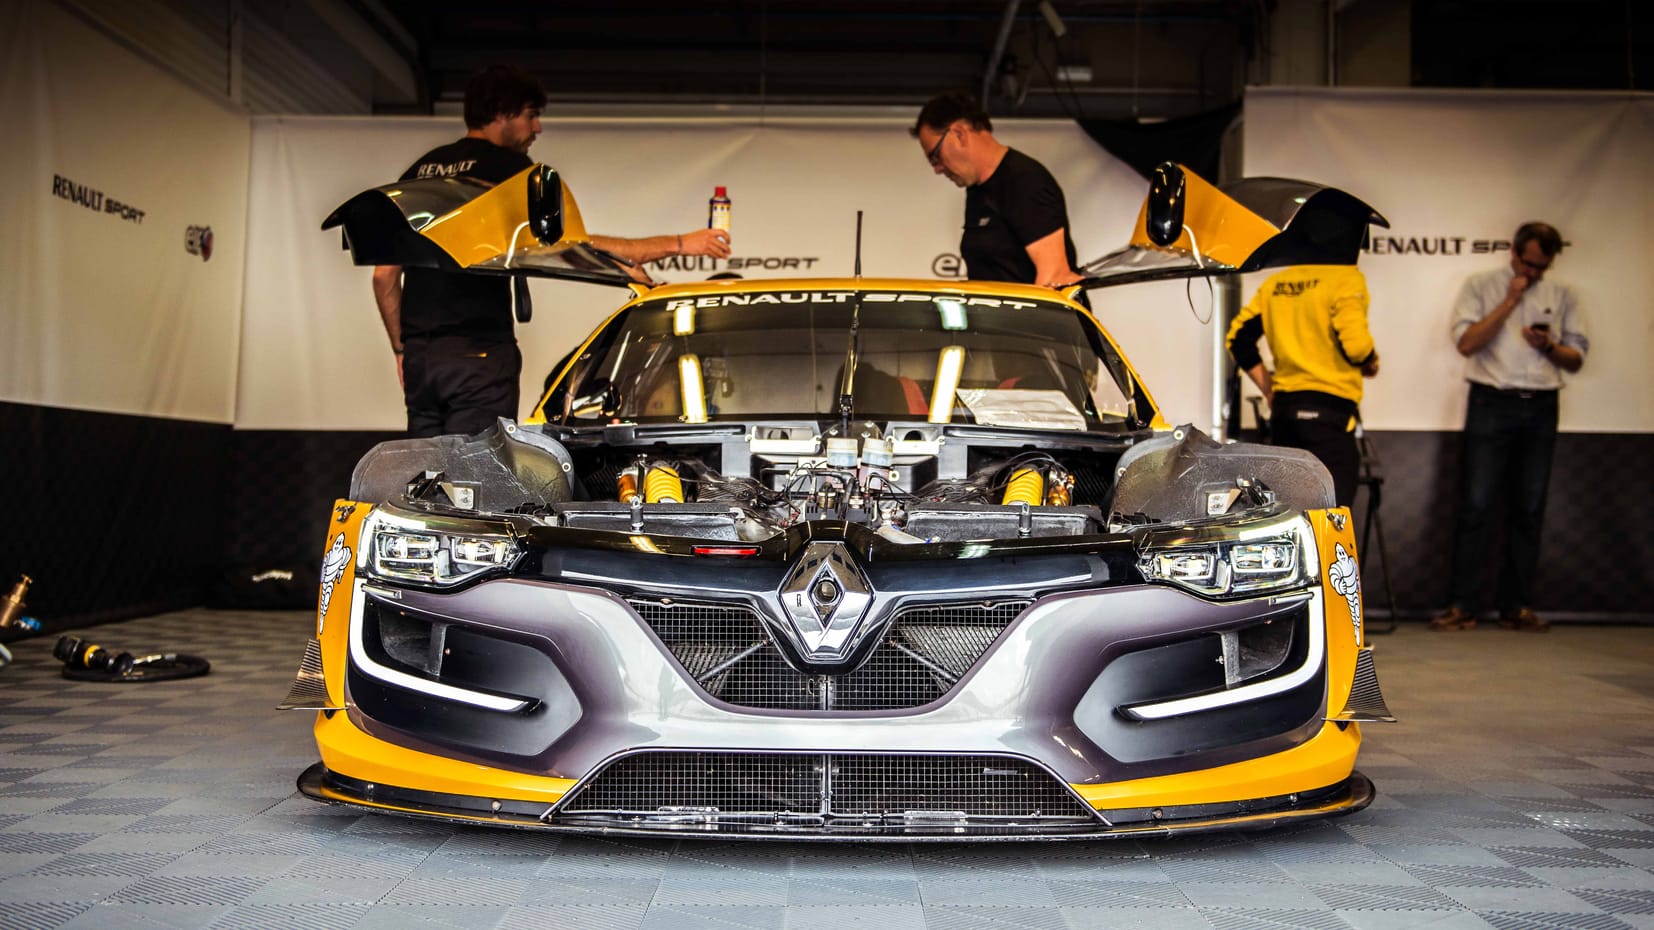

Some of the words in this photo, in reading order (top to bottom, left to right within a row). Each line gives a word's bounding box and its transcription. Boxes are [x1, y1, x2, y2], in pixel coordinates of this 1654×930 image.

[417, 159, 477, 176] RENAULT
[52, 173, 104, 212] RENAULT
[104, 197, 146, 224] SPORT
[1361, 236, 1465, 255] ENAULT
[650, 254, 717, 272] NAULT
[727, 256, 820, 271] SPORT
[665, 292, 857, 312] RENAULT
[861, 293, 1038, 310] SPORT
